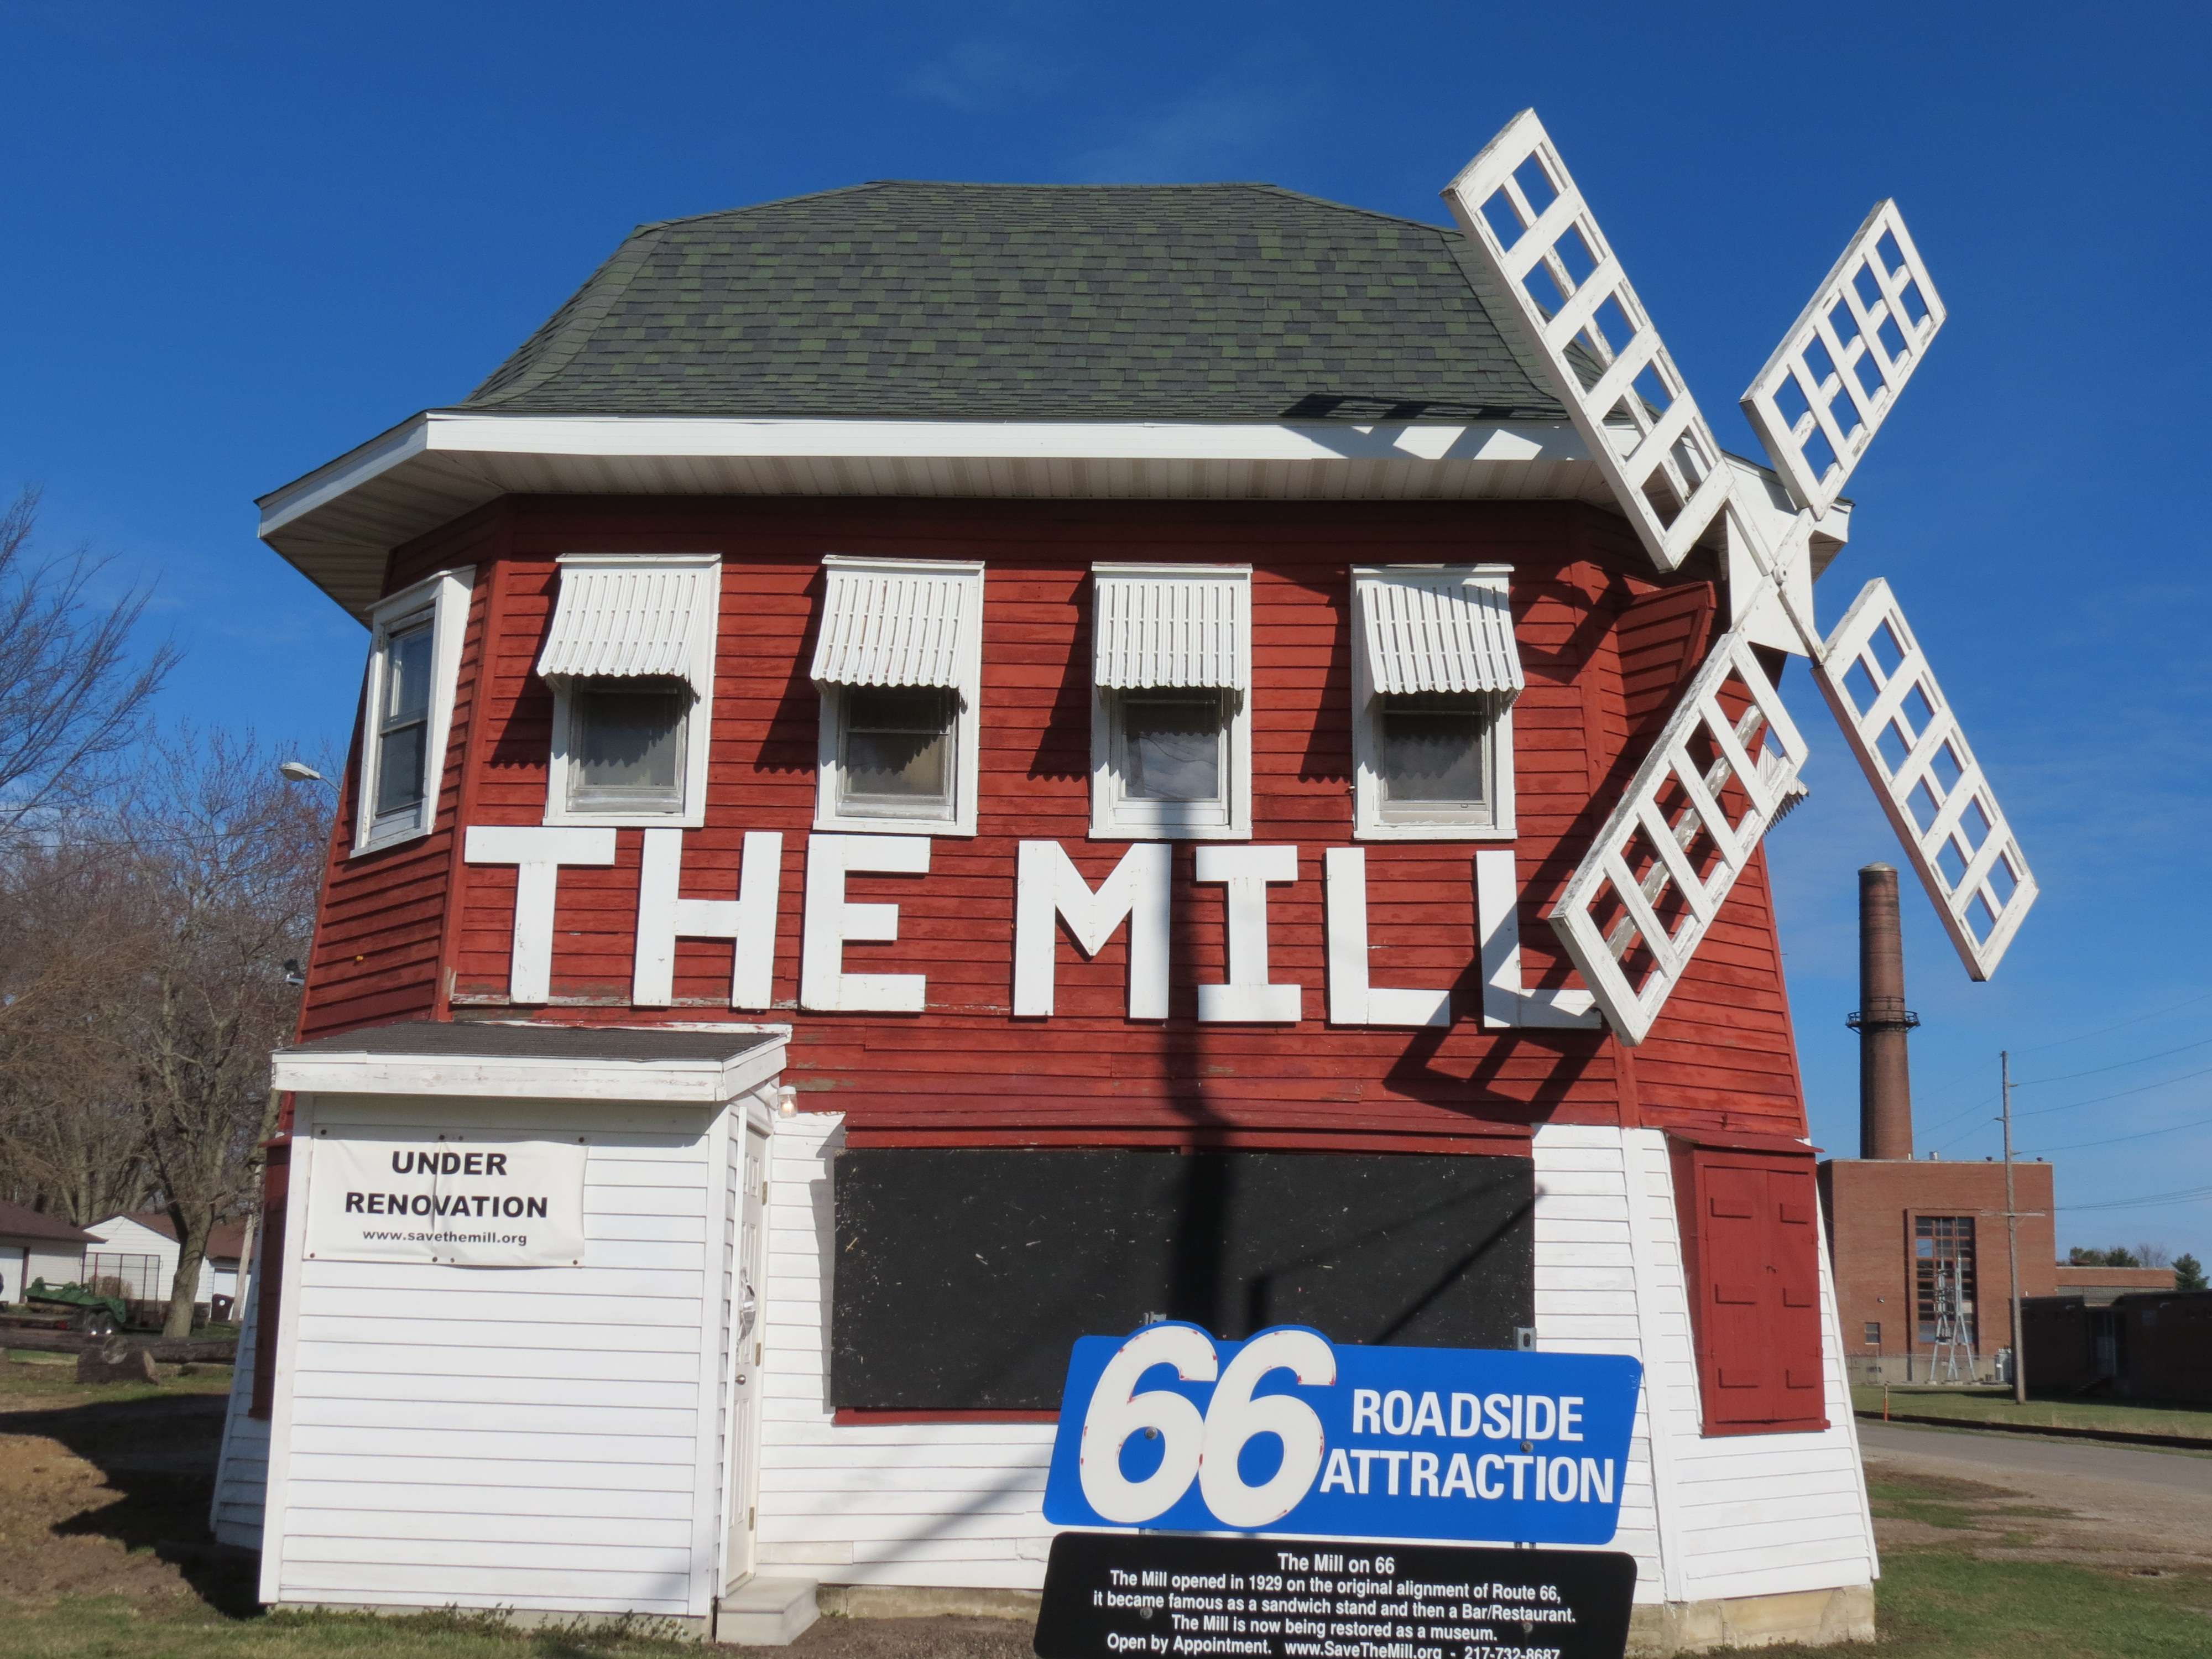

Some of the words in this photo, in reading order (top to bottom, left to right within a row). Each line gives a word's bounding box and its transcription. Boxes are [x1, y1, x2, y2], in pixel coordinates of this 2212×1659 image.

[464, 826, 931, 1013] THE
[1013, 840, 1603, 1028] MILL
[392, 1151, 508, 1176] UNDER
[345, 1192, 548, 1218] RENOVATION
[362, 1230, 527, 1246] www.savethemill.org
[1079, 1324, 1337, 1527] 66
[1352, 1388, 1584, 1442] ROADSIDE
[1318, 1448, 1614, 1503] ATTRACTION
[1277, 1553, 1309, 1571] The
[1314, 1554, 1343, 1572] Mill
[1348, 1559, 1370, 1573] on
[1375, 1557, 1395, 1574] 66
[1110, 1569, 1137, 1585] The
[1142, 1571, 1167, 1587] Mill
[1172, 1573, 1226, 1591] opened
[1231, 1574, 1244, 1590] in
[1249, 1575, 1282, 1592] 1929
[1287, 1578, 1305, 1592] on
[1310, 1577, 1333, 1593] the
[1337, 1579, 1392, 1597] original
[1396, 1580, 1469, 1600] alignment
[1473, 1583, 1489, 1598] of
[1493, 1584, 1535, 1600] Route
[1540, 1585, 1561, 1603] 66,
[1094, 1590, 1102, 1606] it
[1108, 1591, 1164, 1608] became
[1168, 1593, 1223, 1610] famous
[1228, 1597, 1244, 1611] as
[1248, 1598, 1257, 1611] a
[1261, 1597, 1331, 1614] sandwich
[1336, 1600, 1376, 1616] stand
[1381, 1602, 1407, 1617] and
[1413, 1602, 1444, 1619] then
[1449, 1606, 1457, 1619] a
[1463, 1604, 1575, 1623] Bar/Restaurant.
[1172, 1614, 1198, 1630] The
[1204, 1615, 1228, 1631] Mill
[1233, 1617, 1245, 1632] is
[1250, 1619, 1281, 1633] now
[1286, 1619, 1325, 1638] being
[1331, 1622, 1391, 1637] restored
[1396, 1625, 1413, 1638] as
[1417, 1626, 1426, 1638] a
[1431, 1627, 1498, 1641] museum.
[1107, 1633, 1146, 1652] Open
[1151, 1635, 1168, 1653] by
[1173, 1636, 1271, 1656] Appointment.
[1285, 1641, 1442, 1659] www.SaveTheMill.org
